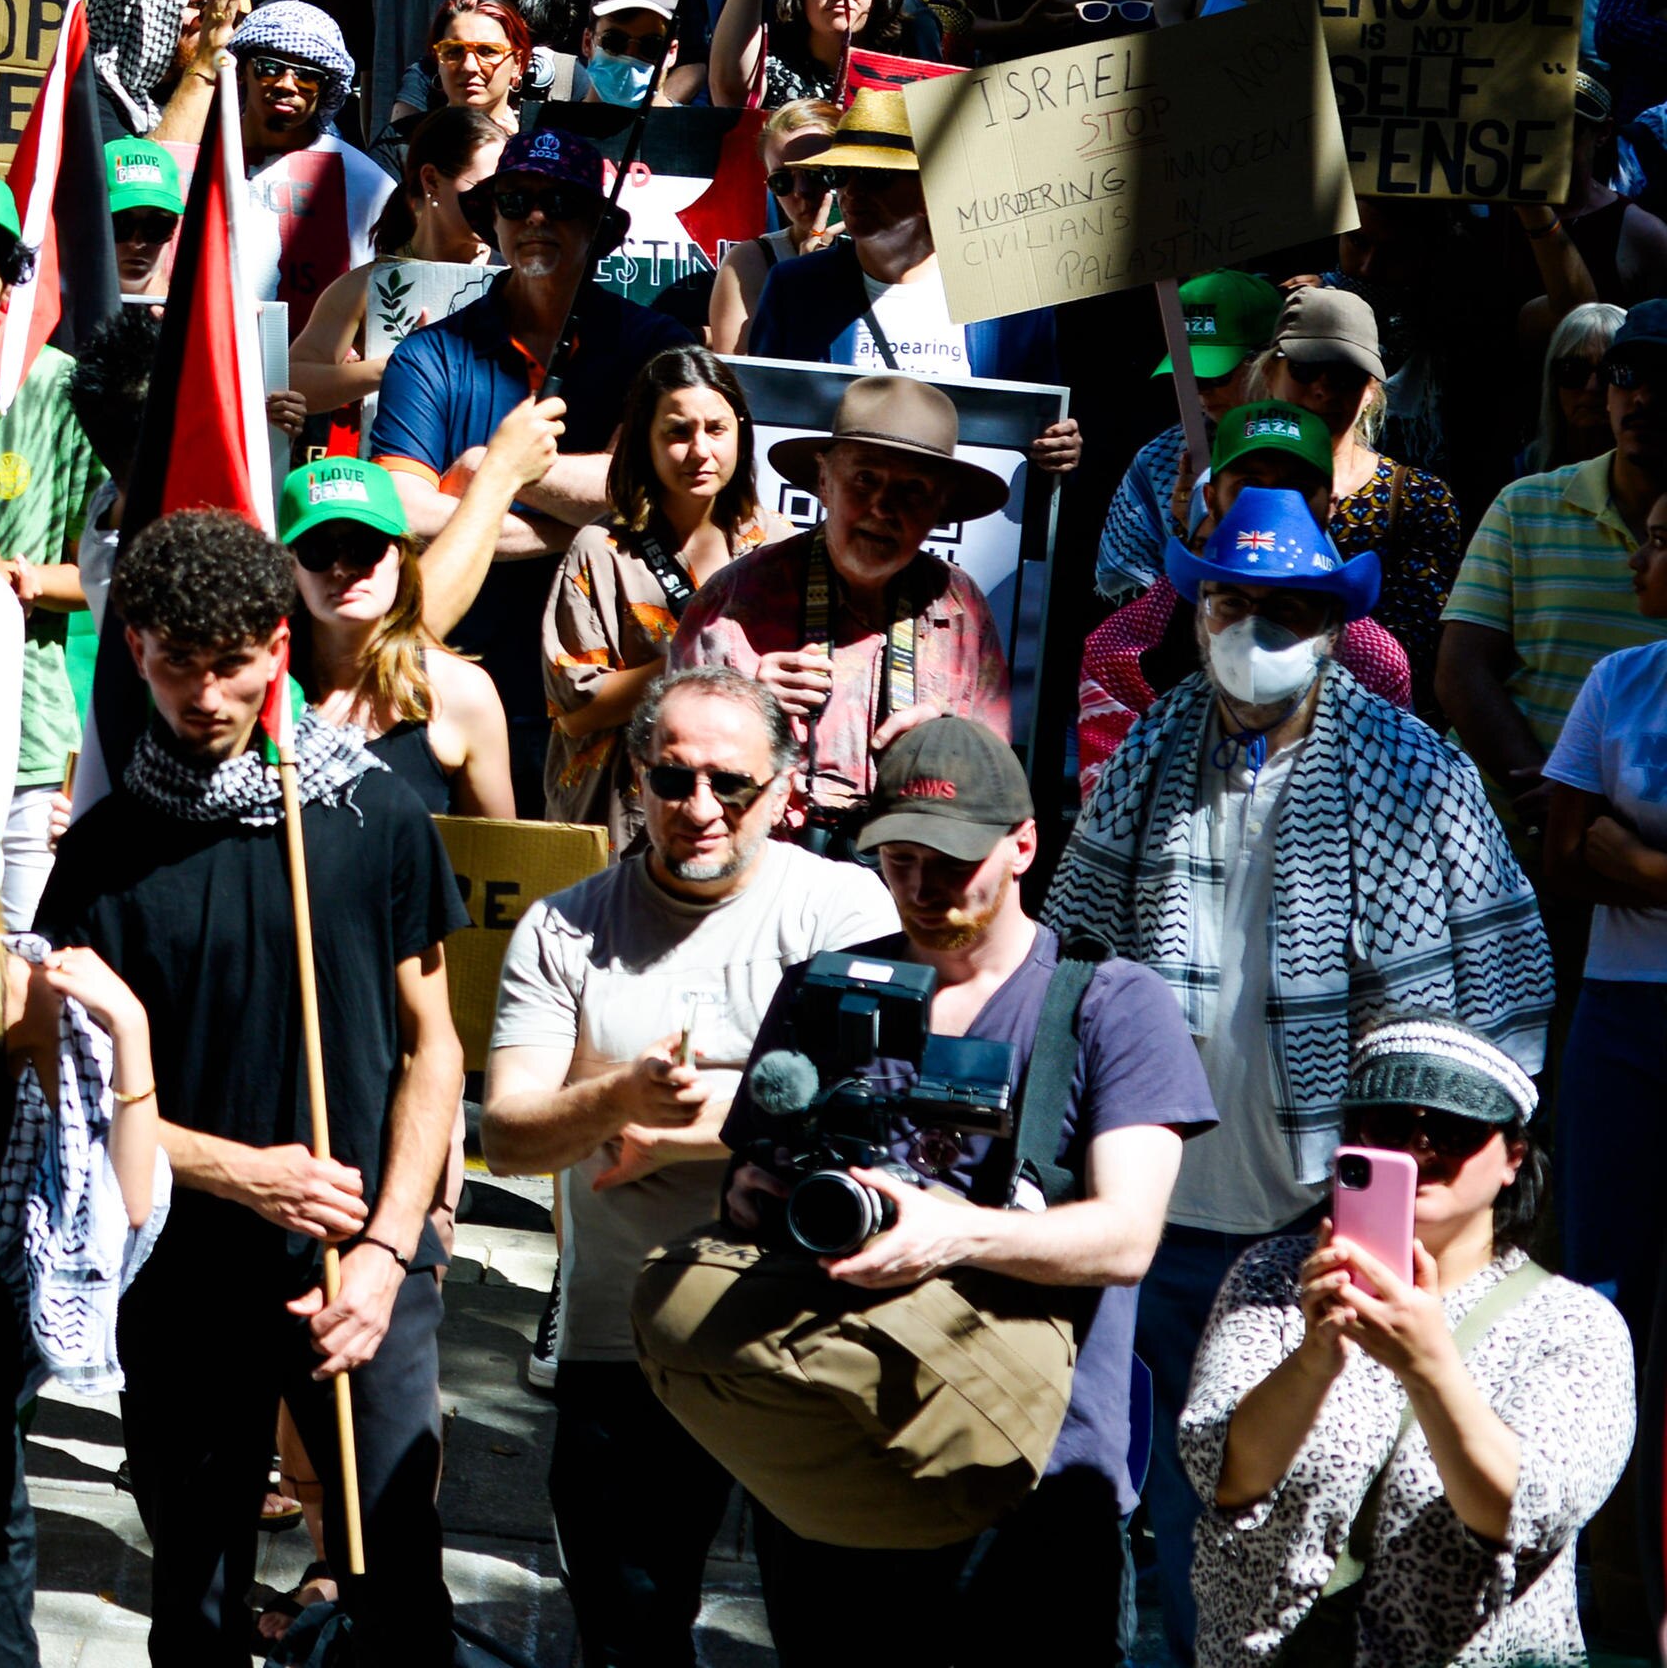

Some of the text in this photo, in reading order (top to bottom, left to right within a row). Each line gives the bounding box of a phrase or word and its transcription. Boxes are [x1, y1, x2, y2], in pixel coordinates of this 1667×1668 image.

[1360, 22, 1472, 54] IS NOT
[973, 48, 1158, 128] ISRAEL
[1333, 55, 1496, 118] SELF
[1076, 94, 1172, 151] STOP
[126, 154, 160, 168] LOVE
[529, 150, 560, 160] 2023
[1346, 117, 1555, 201] FENSE
[1259, 409, 1301, 424] LOVE
[1244, 422, 1301, 439] GAZA
[320, 467, 364, 483] LOVE
[900, 779, 958, 800] JAWS
